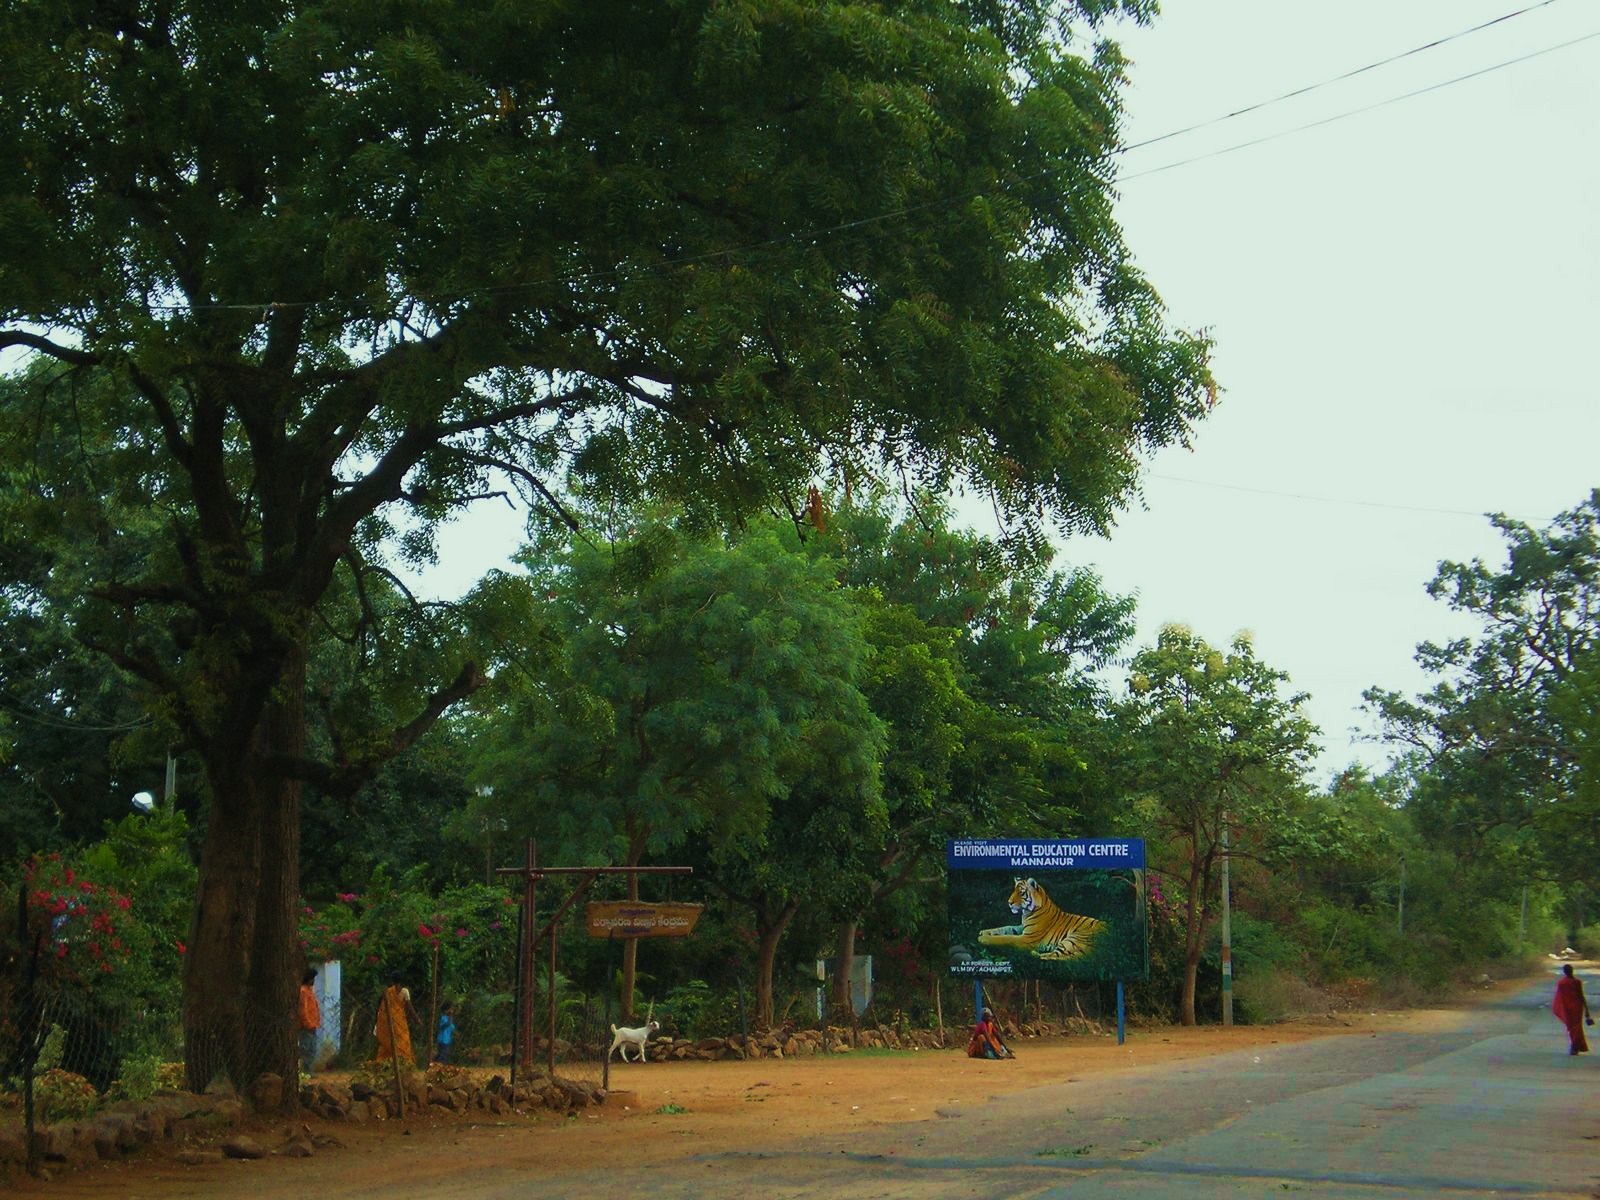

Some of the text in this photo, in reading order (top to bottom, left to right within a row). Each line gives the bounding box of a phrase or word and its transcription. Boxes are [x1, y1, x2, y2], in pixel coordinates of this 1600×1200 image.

[954, 844, 1129, 857] ENVIRONMENTAL EDUCATION CENTRE
[1011, 857, 1074, 866] MANNANUR
